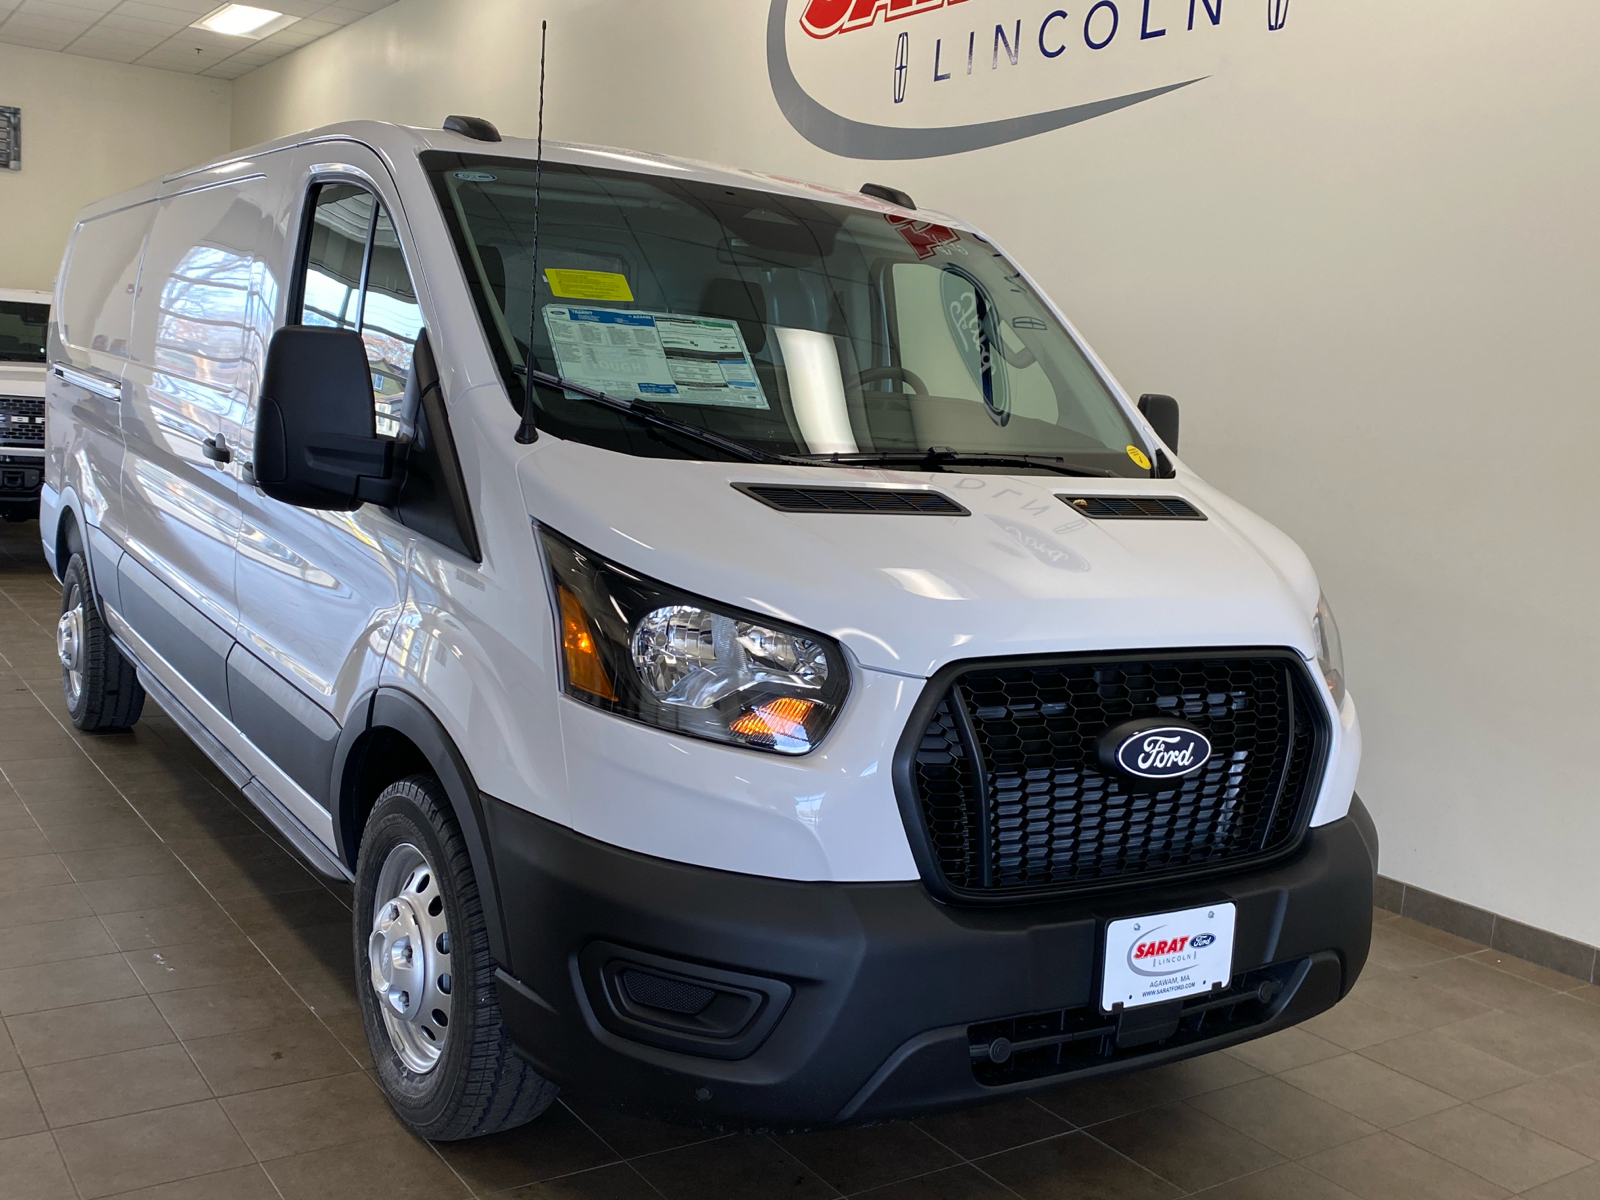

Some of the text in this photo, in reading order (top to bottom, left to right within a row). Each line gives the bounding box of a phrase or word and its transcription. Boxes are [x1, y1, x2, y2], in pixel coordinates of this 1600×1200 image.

[934, 0, 1222, 82] LINCOLN
[1138, 736, 1194, 769] Ford
[1133, 934, 1213, 959] SARAT Ford
[1158, 954, 1192, 966] LINCOLN
[1142, 982, 1196, 998] WWW.SARATFORD.COM
[1149, 974, 1191, 989] AGAWAM, MA
